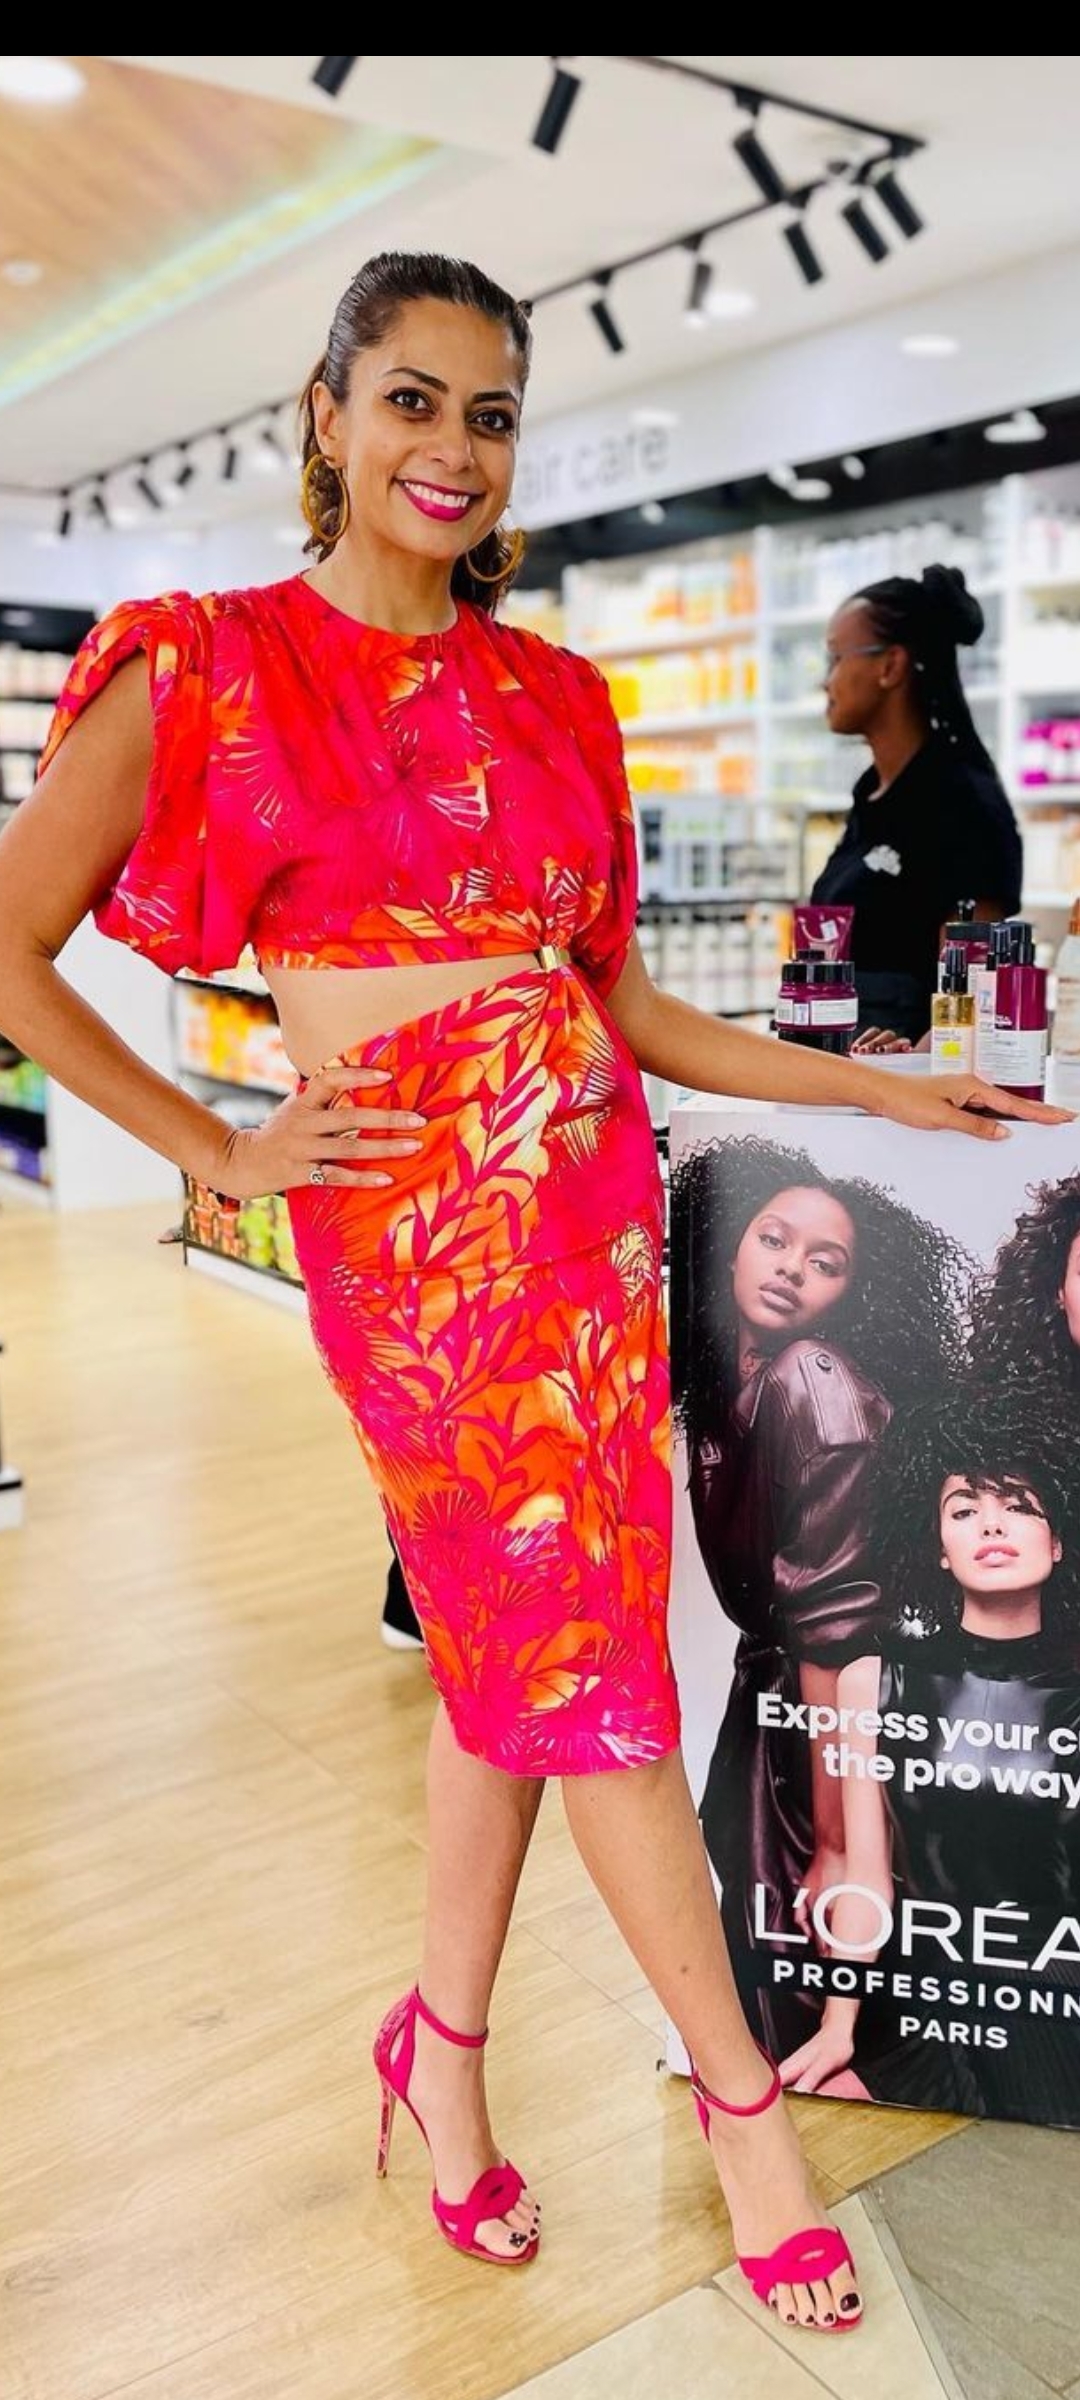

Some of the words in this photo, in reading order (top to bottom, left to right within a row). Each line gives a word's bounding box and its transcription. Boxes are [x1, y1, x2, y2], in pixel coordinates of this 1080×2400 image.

[516, 444, 563, 505] air
[570, 425, 669, 492] care
[757, 1692, 929, 1743] Express
[937, 1716, 1040, 1753] your
[1048, 1726, 1080, 1756] c
[822, 1743, 896, 1782] the
[904, 1757, 981, 1793] pro
[990, 1766, 1080, 1809] way
[773, 1959, 1080, 2018] PROFESSIONN
[900, 2016, 1008, 2049] PARIS
